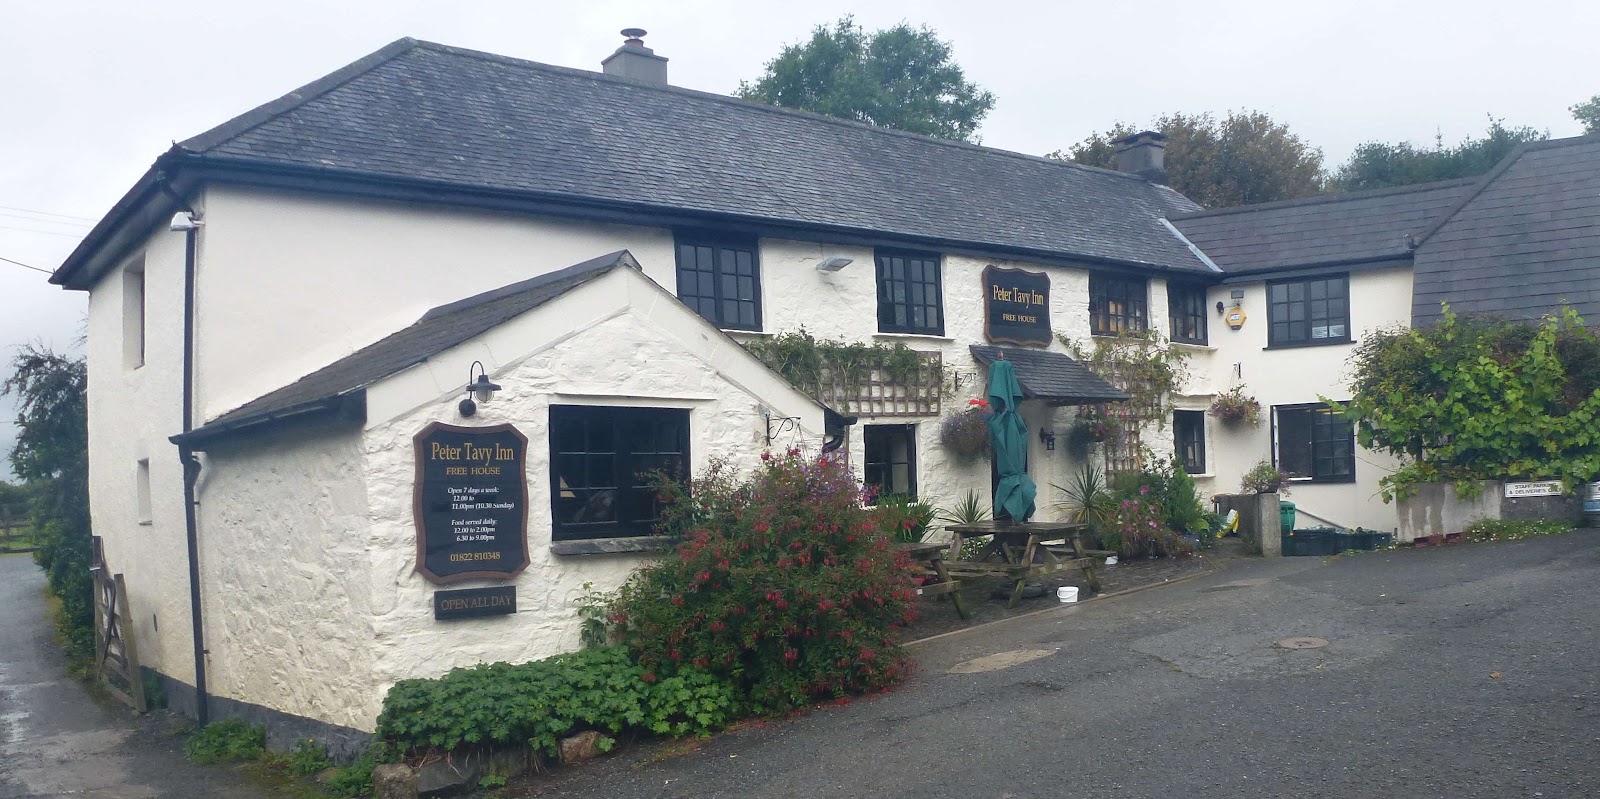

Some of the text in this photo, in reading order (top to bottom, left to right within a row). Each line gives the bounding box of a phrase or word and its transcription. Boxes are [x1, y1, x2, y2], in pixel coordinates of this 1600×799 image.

[993, 285, 1044, 308] Peter Tavy Inn
[1018, 315, 1036, 323] HOUSE
[432, 442, 514, 466] Peter Tavy Inn
[446, 467, 500, 475] FREE HOUSE
[493, 502, 514, 510] Sunday)
[450, 552, 500, 561] 01822 810348
[442, 595, 512, 610] OPEN ALL DAY
